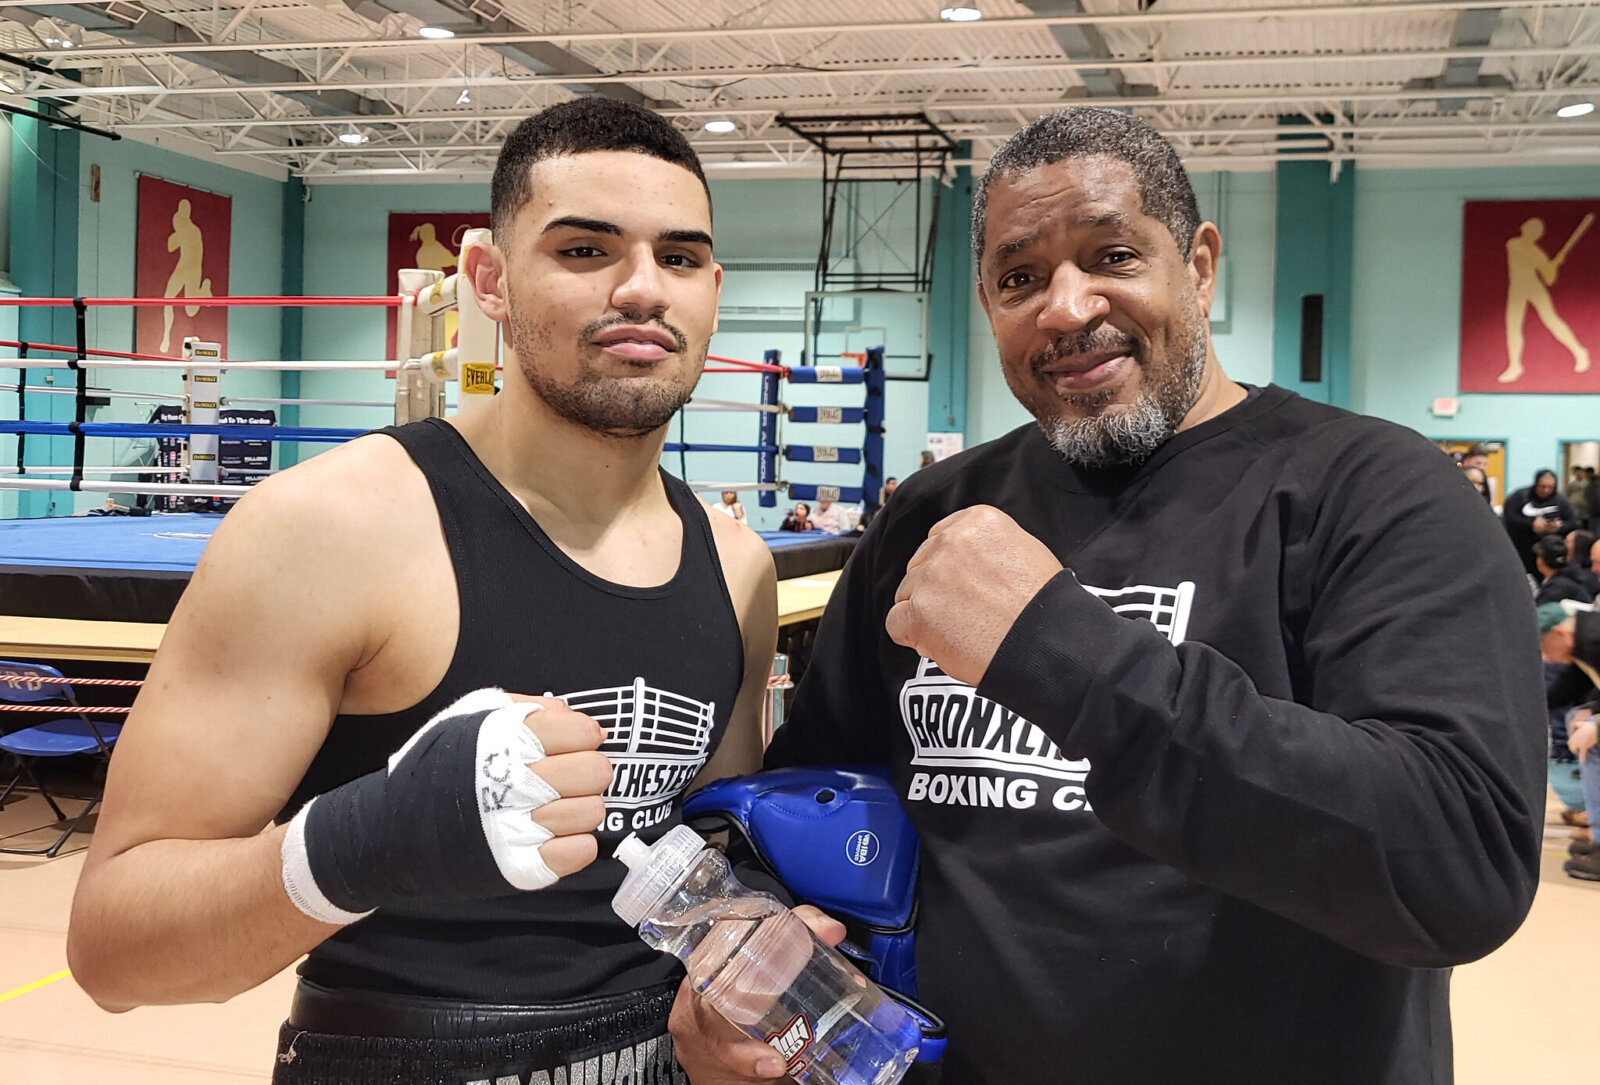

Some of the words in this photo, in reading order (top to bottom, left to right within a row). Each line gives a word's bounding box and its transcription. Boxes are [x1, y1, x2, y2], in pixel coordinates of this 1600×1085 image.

[466, 367, 495, 388] EVERLA
[908, 694, 1063, 761] BRONXLI
[603, 763, 698, 797] CHESTER
[907, 772, 1039, 809] BOXING
[1052, 785, 1093, 811] C
[631, 800, 673, 830] CLUB
[784, 1042, 801, 1060] DER
